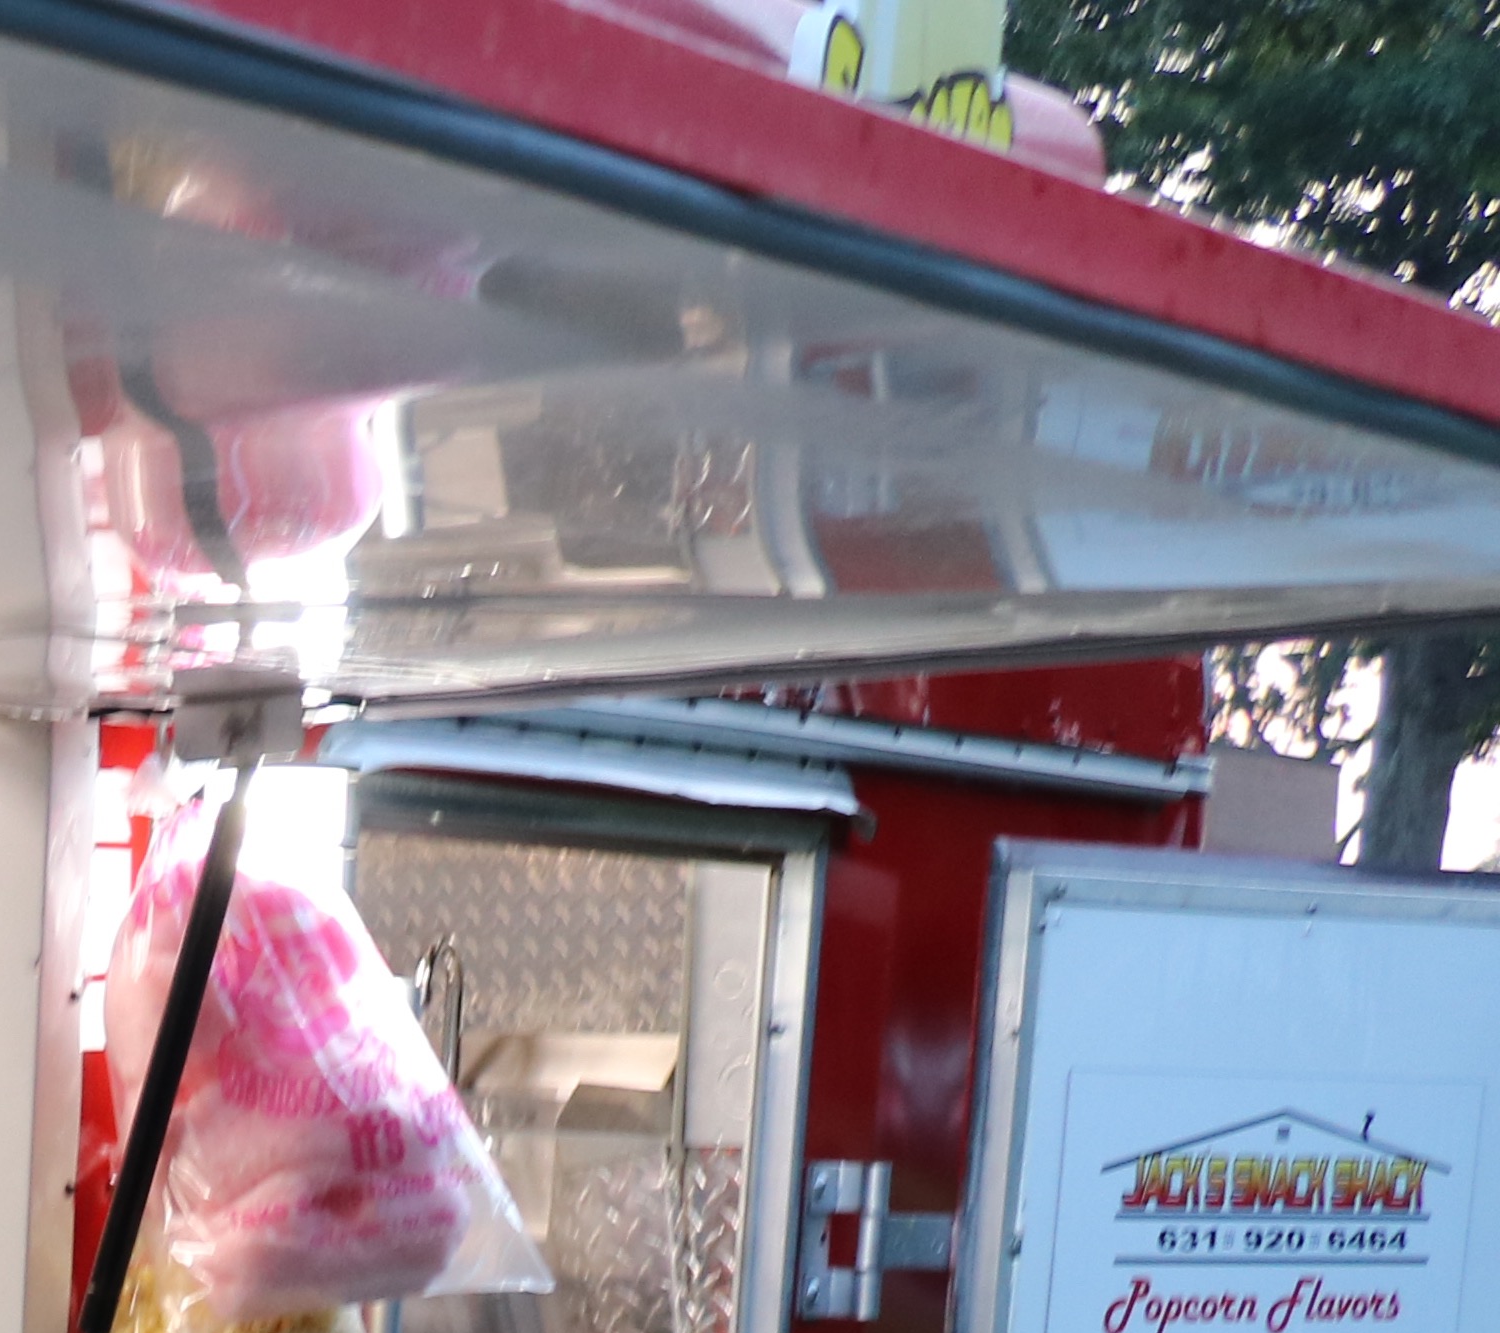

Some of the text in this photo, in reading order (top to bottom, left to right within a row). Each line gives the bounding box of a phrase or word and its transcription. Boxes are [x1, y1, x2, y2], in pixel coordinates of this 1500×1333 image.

[1230, 1154, 1329, 1213] SNACK
[1330, 1154, 1429, 1214] SHACK
[1158, 1226, 1409, 1252] 631 920 6464
